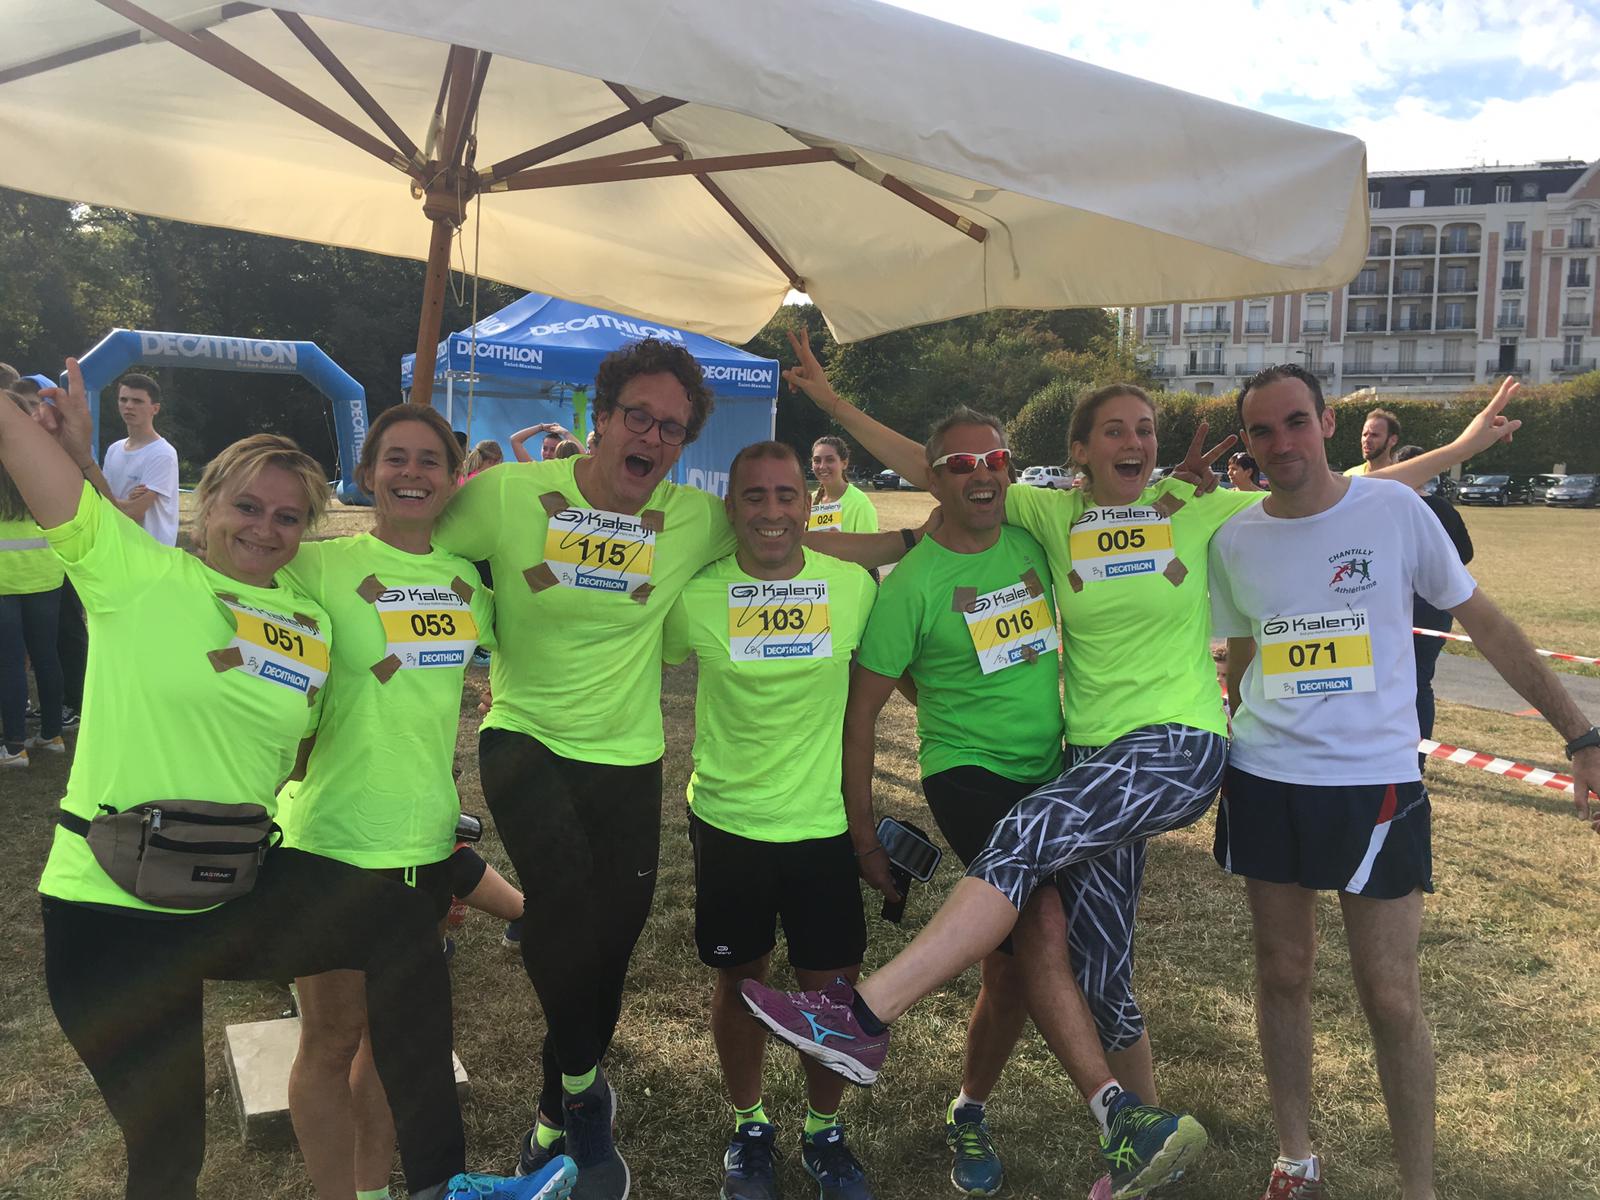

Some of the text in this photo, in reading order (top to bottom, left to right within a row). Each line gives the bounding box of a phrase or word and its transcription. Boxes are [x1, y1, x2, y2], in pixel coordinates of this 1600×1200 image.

[530, 314, 684, 341] DECATHLON
[141, 333, 297, 364] DECATHLON
[456, 340, 543, 364] DECATHLON
[701, 365, 773, 382] DECATHLON
[817, 514, 833, 525] 024
[1097, 528, 1146, 552] 005
[578, 539, 626, 566] 115
[1328, 548, 1374, 563] CHANTILLY
[1108, 562, 1152, 574] DECATHLON
[562, 572, 625, 590] By DECATHLON
[408, 588, 464, 606] Kalenj
[762, 583, 825, 600] Kalenji
[410, 613, 456, 637] 053
[758, 608, 805, 631] 103
[995, 609, 1034, 639] 016
[1292, 613, 1365, 632] Kalenji
[263, 622, 304, 657] 051
[421, 652, 462, 663] DECATHLON
[766, 645, 810, 655] DECATHLON
[1010, 641, 1044, 660] DECON
[1288, 641, 1337, 667] 071
[247, 656, 307, 688] By DECATHLON
[1299, 680, 1349, 691] DECATHLON
